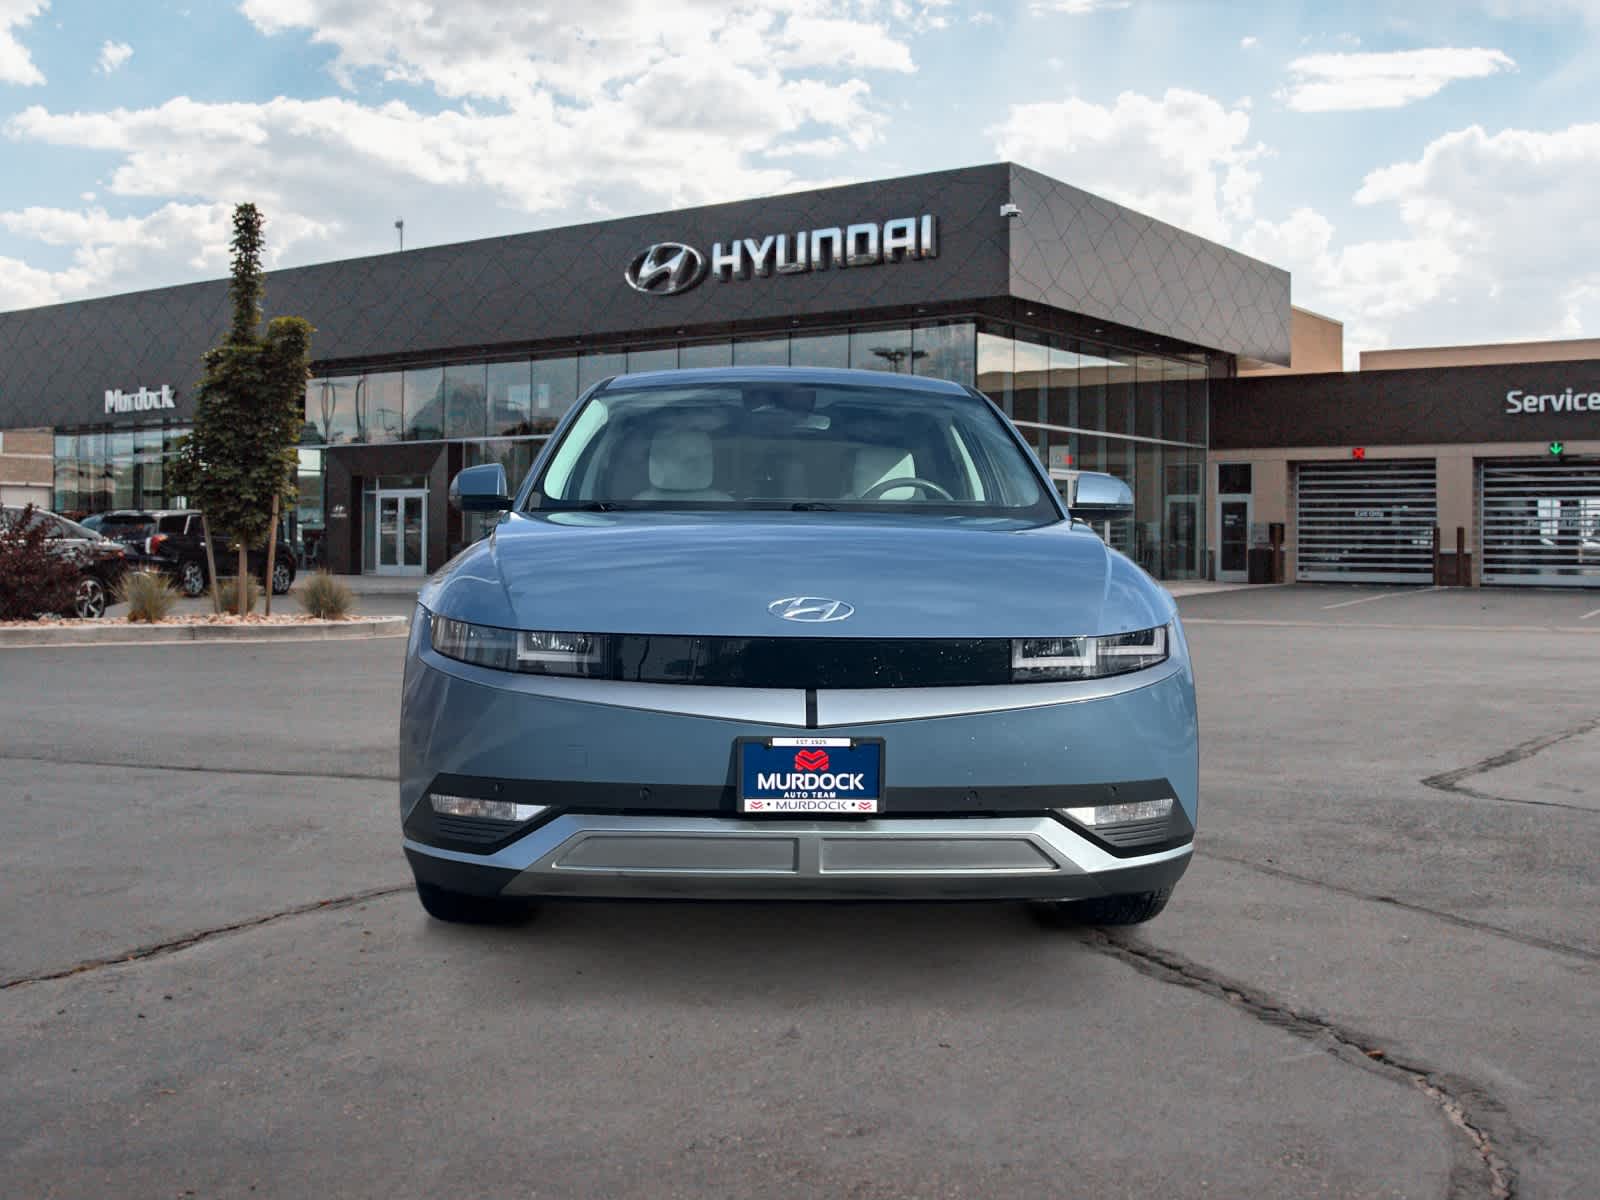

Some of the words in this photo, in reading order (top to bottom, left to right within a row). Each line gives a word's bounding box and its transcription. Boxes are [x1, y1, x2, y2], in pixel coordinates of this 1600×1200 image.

[712, 214, 936, 282] HYUNDAI
[104, 384, 176, 414] Murdock
[1505, 387, 1600, 414] Service
[757, 773, 864, 790] MURDOCK
[776, 801, 848, 810] MURDOCK
